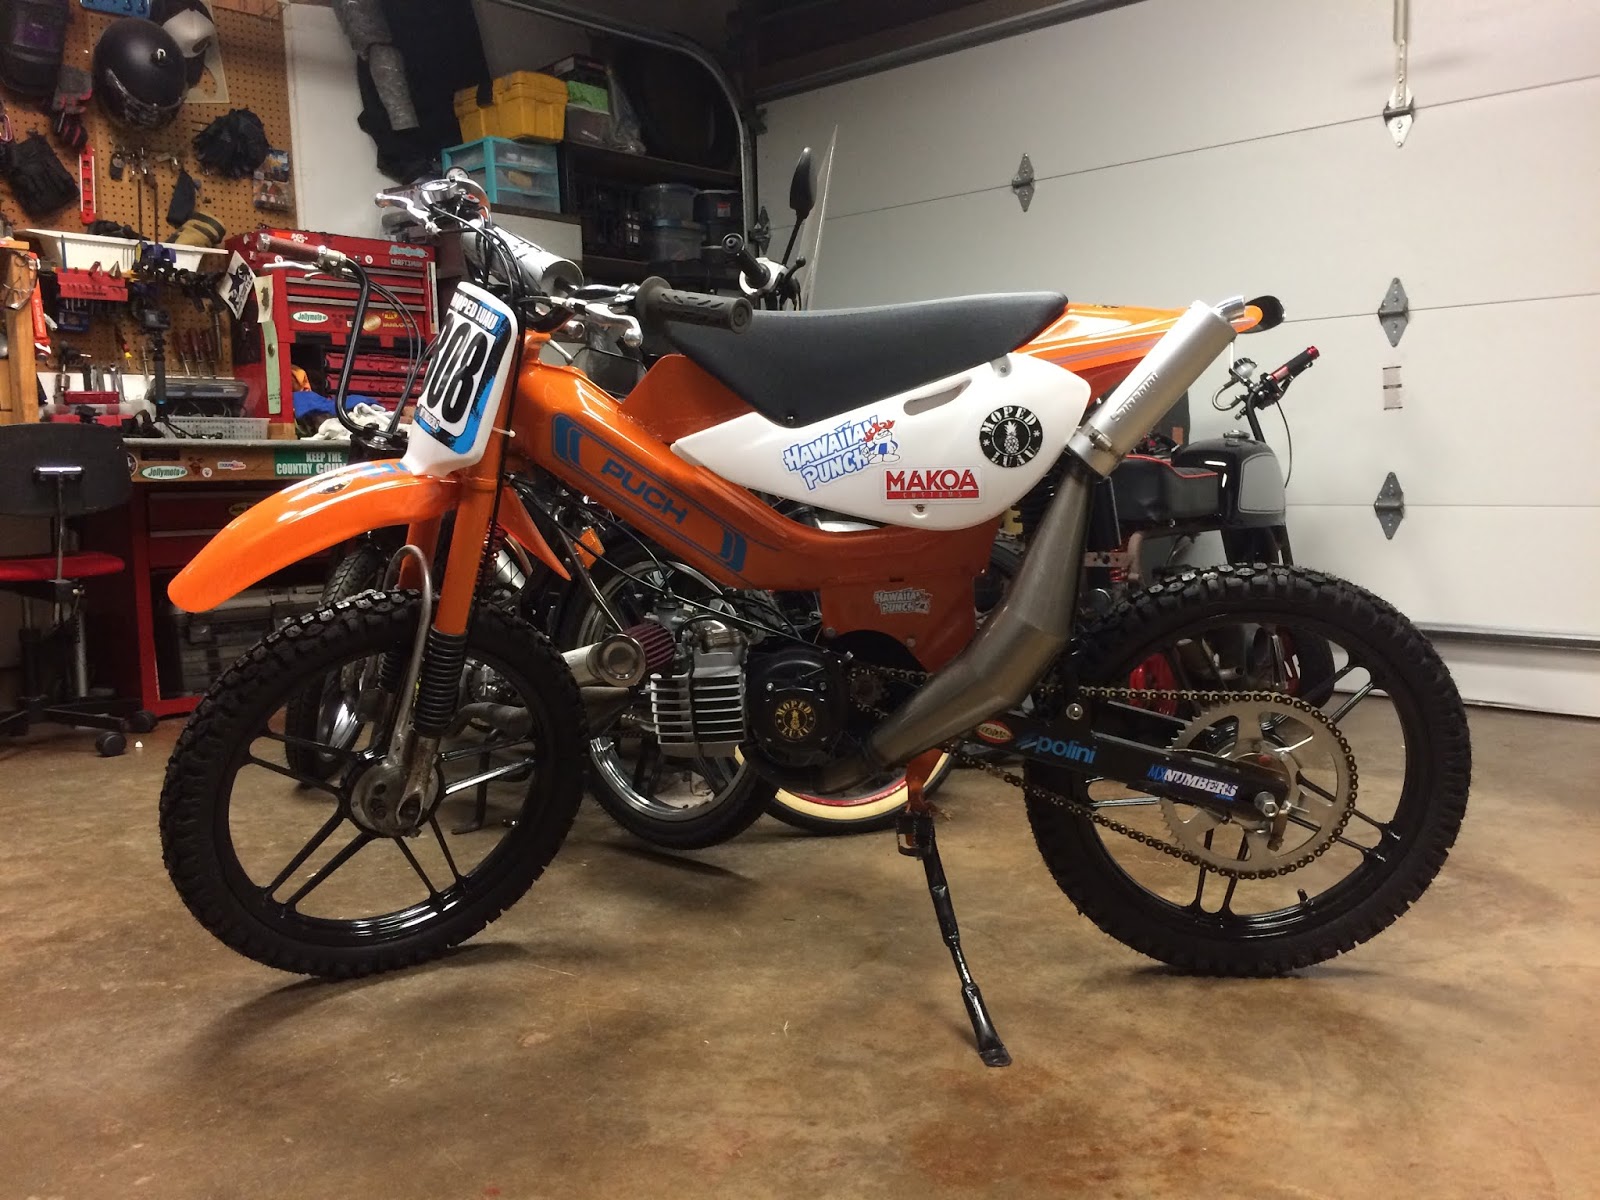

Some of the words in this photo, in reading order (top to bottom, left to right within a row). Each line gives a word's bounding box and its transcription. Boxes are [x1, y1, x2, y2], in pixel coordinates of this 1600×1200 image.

[981, 405, 1038, 435] MOPED
[306, 452, 325, 462] KEEP
[327, 452, 342, 463] THE
[801, 443, 870, 491] PUNCH
[991, 446, 1036, 467] LUAU
[148, 466, 182, 477] Jollymoto
[276, 463, 313, 474] COUNTRY
[886, 469, 979, 490] MAKOA
[601, 459, 688, 524] PUCH
[1036, 736, 1097, 764] polini
